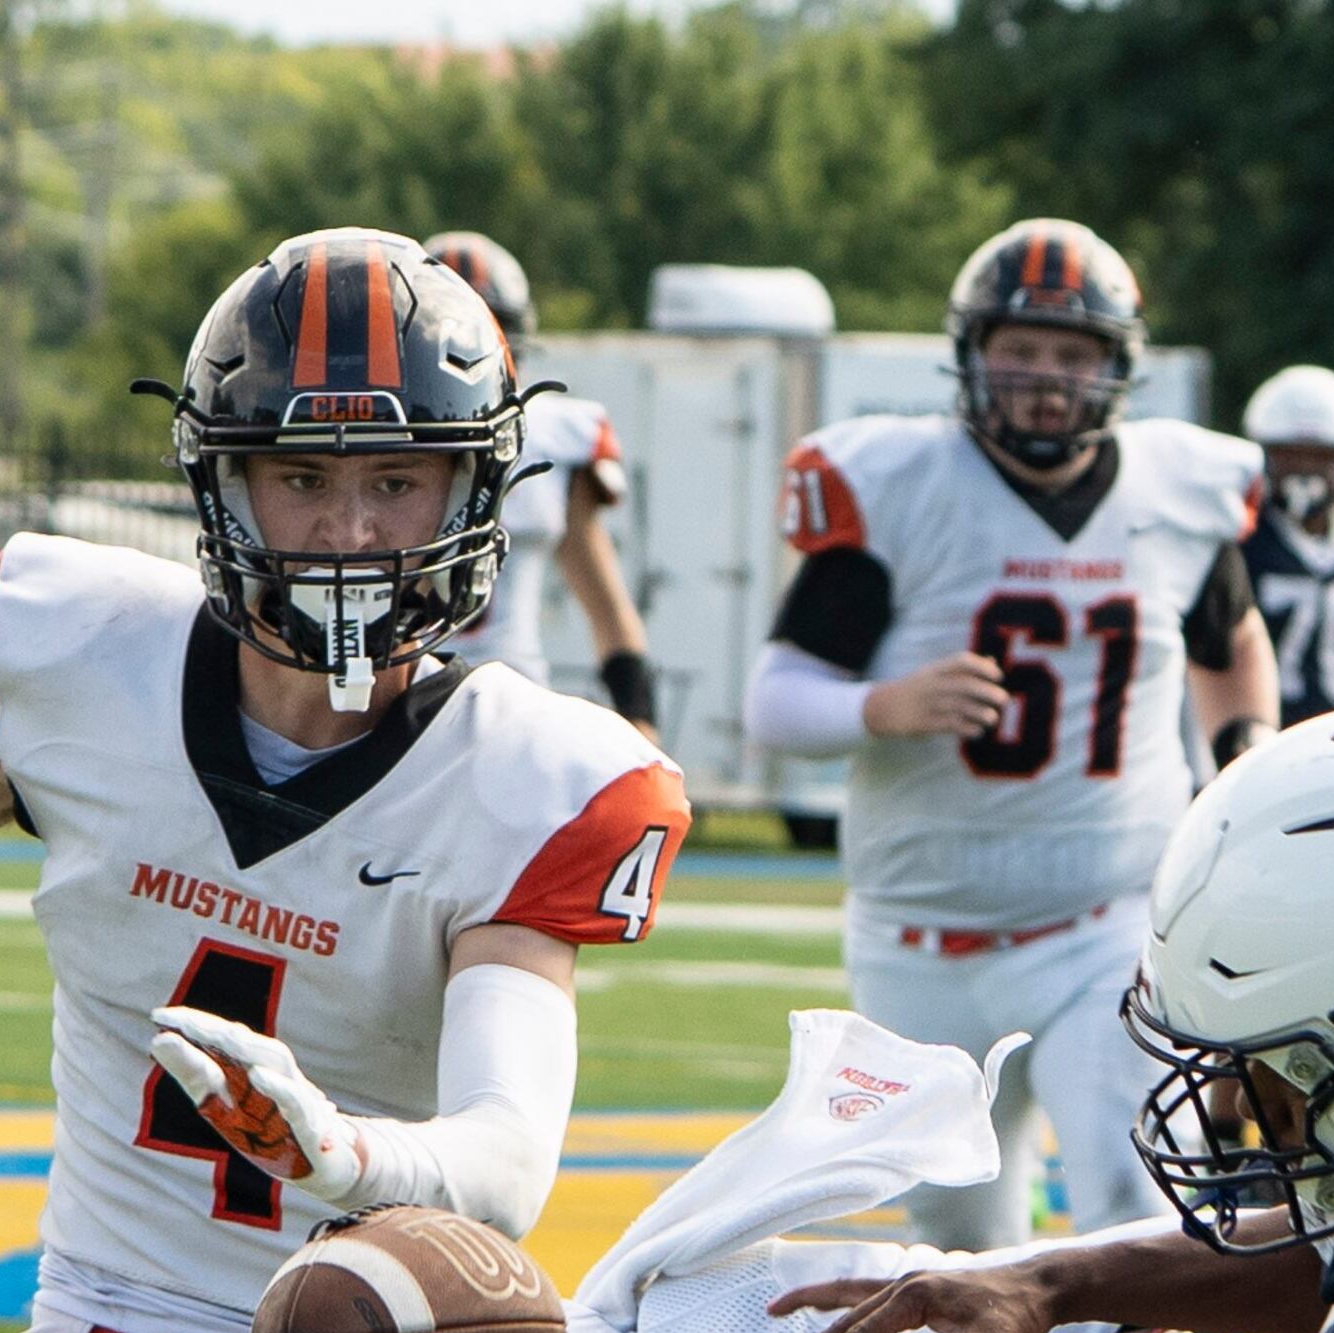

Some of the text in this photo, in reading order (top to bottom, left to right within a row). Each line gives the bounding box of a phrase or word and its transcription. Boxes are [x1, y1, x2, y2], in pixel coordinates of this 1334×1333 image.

[311, 395, 374, 420] CLIO
[959, 591, 1141, 782] 61
[130, 863, 340, 957] MUSTANGS
[598, 825, 668, 942] 4
[133, 936, 288, 1232] 4
